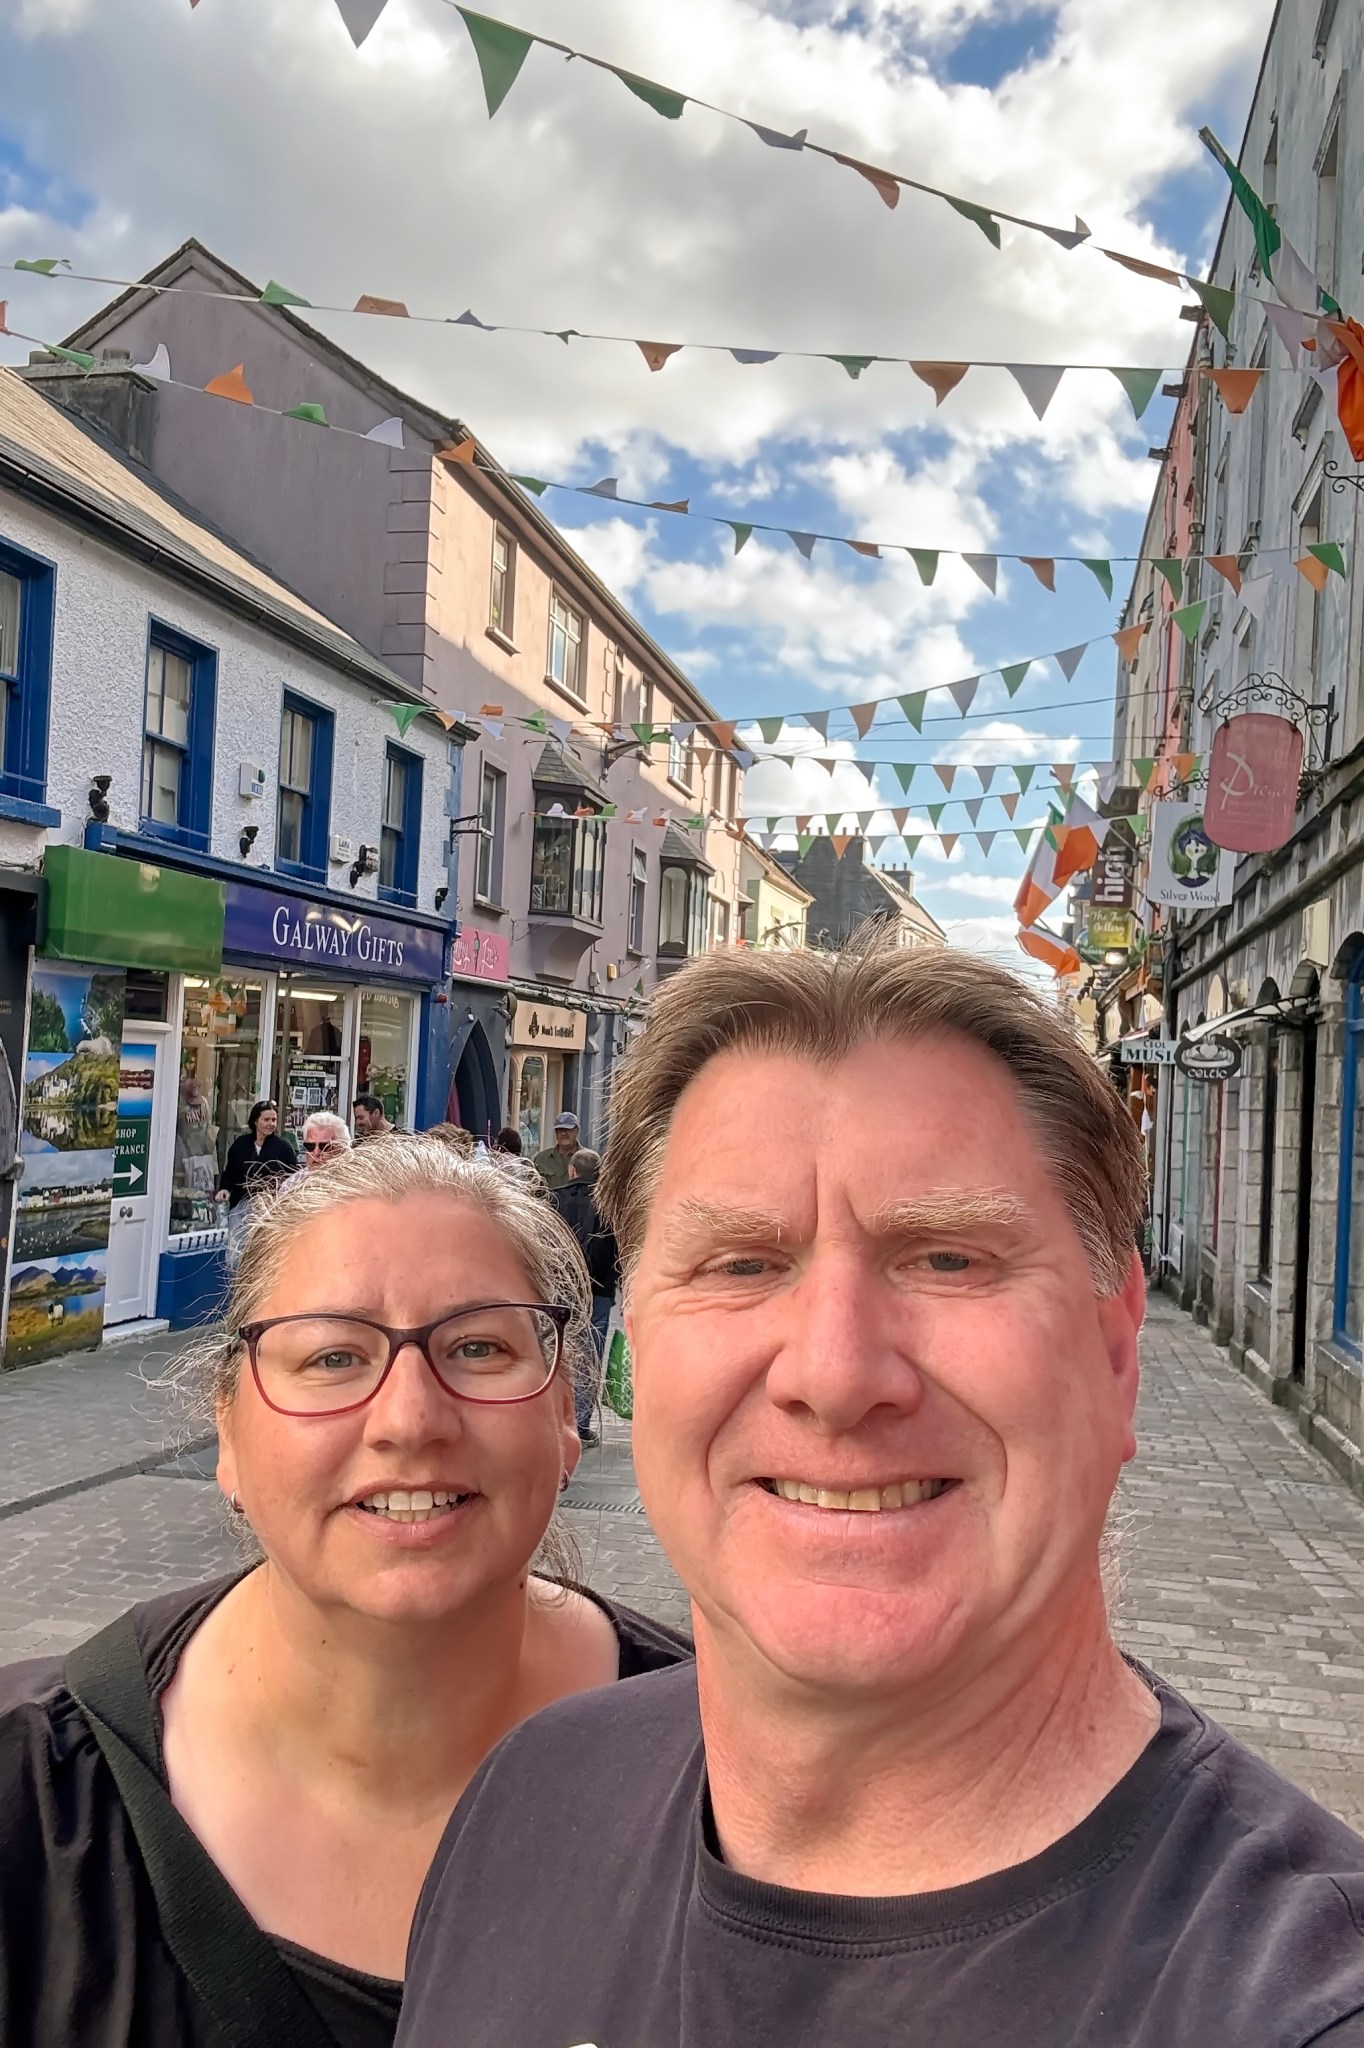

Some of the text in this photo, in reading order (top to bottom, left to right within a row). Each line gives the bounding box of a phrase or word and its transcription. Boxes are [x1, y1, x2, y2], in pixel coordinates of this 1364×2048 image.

[1095, 844, 1132, 902] high
[1160, 889, 1220, 903] Silver Wood
[1126, 1048, 1171, 1062] MUSI
[115, 1128, 137, 1139] SHOP
